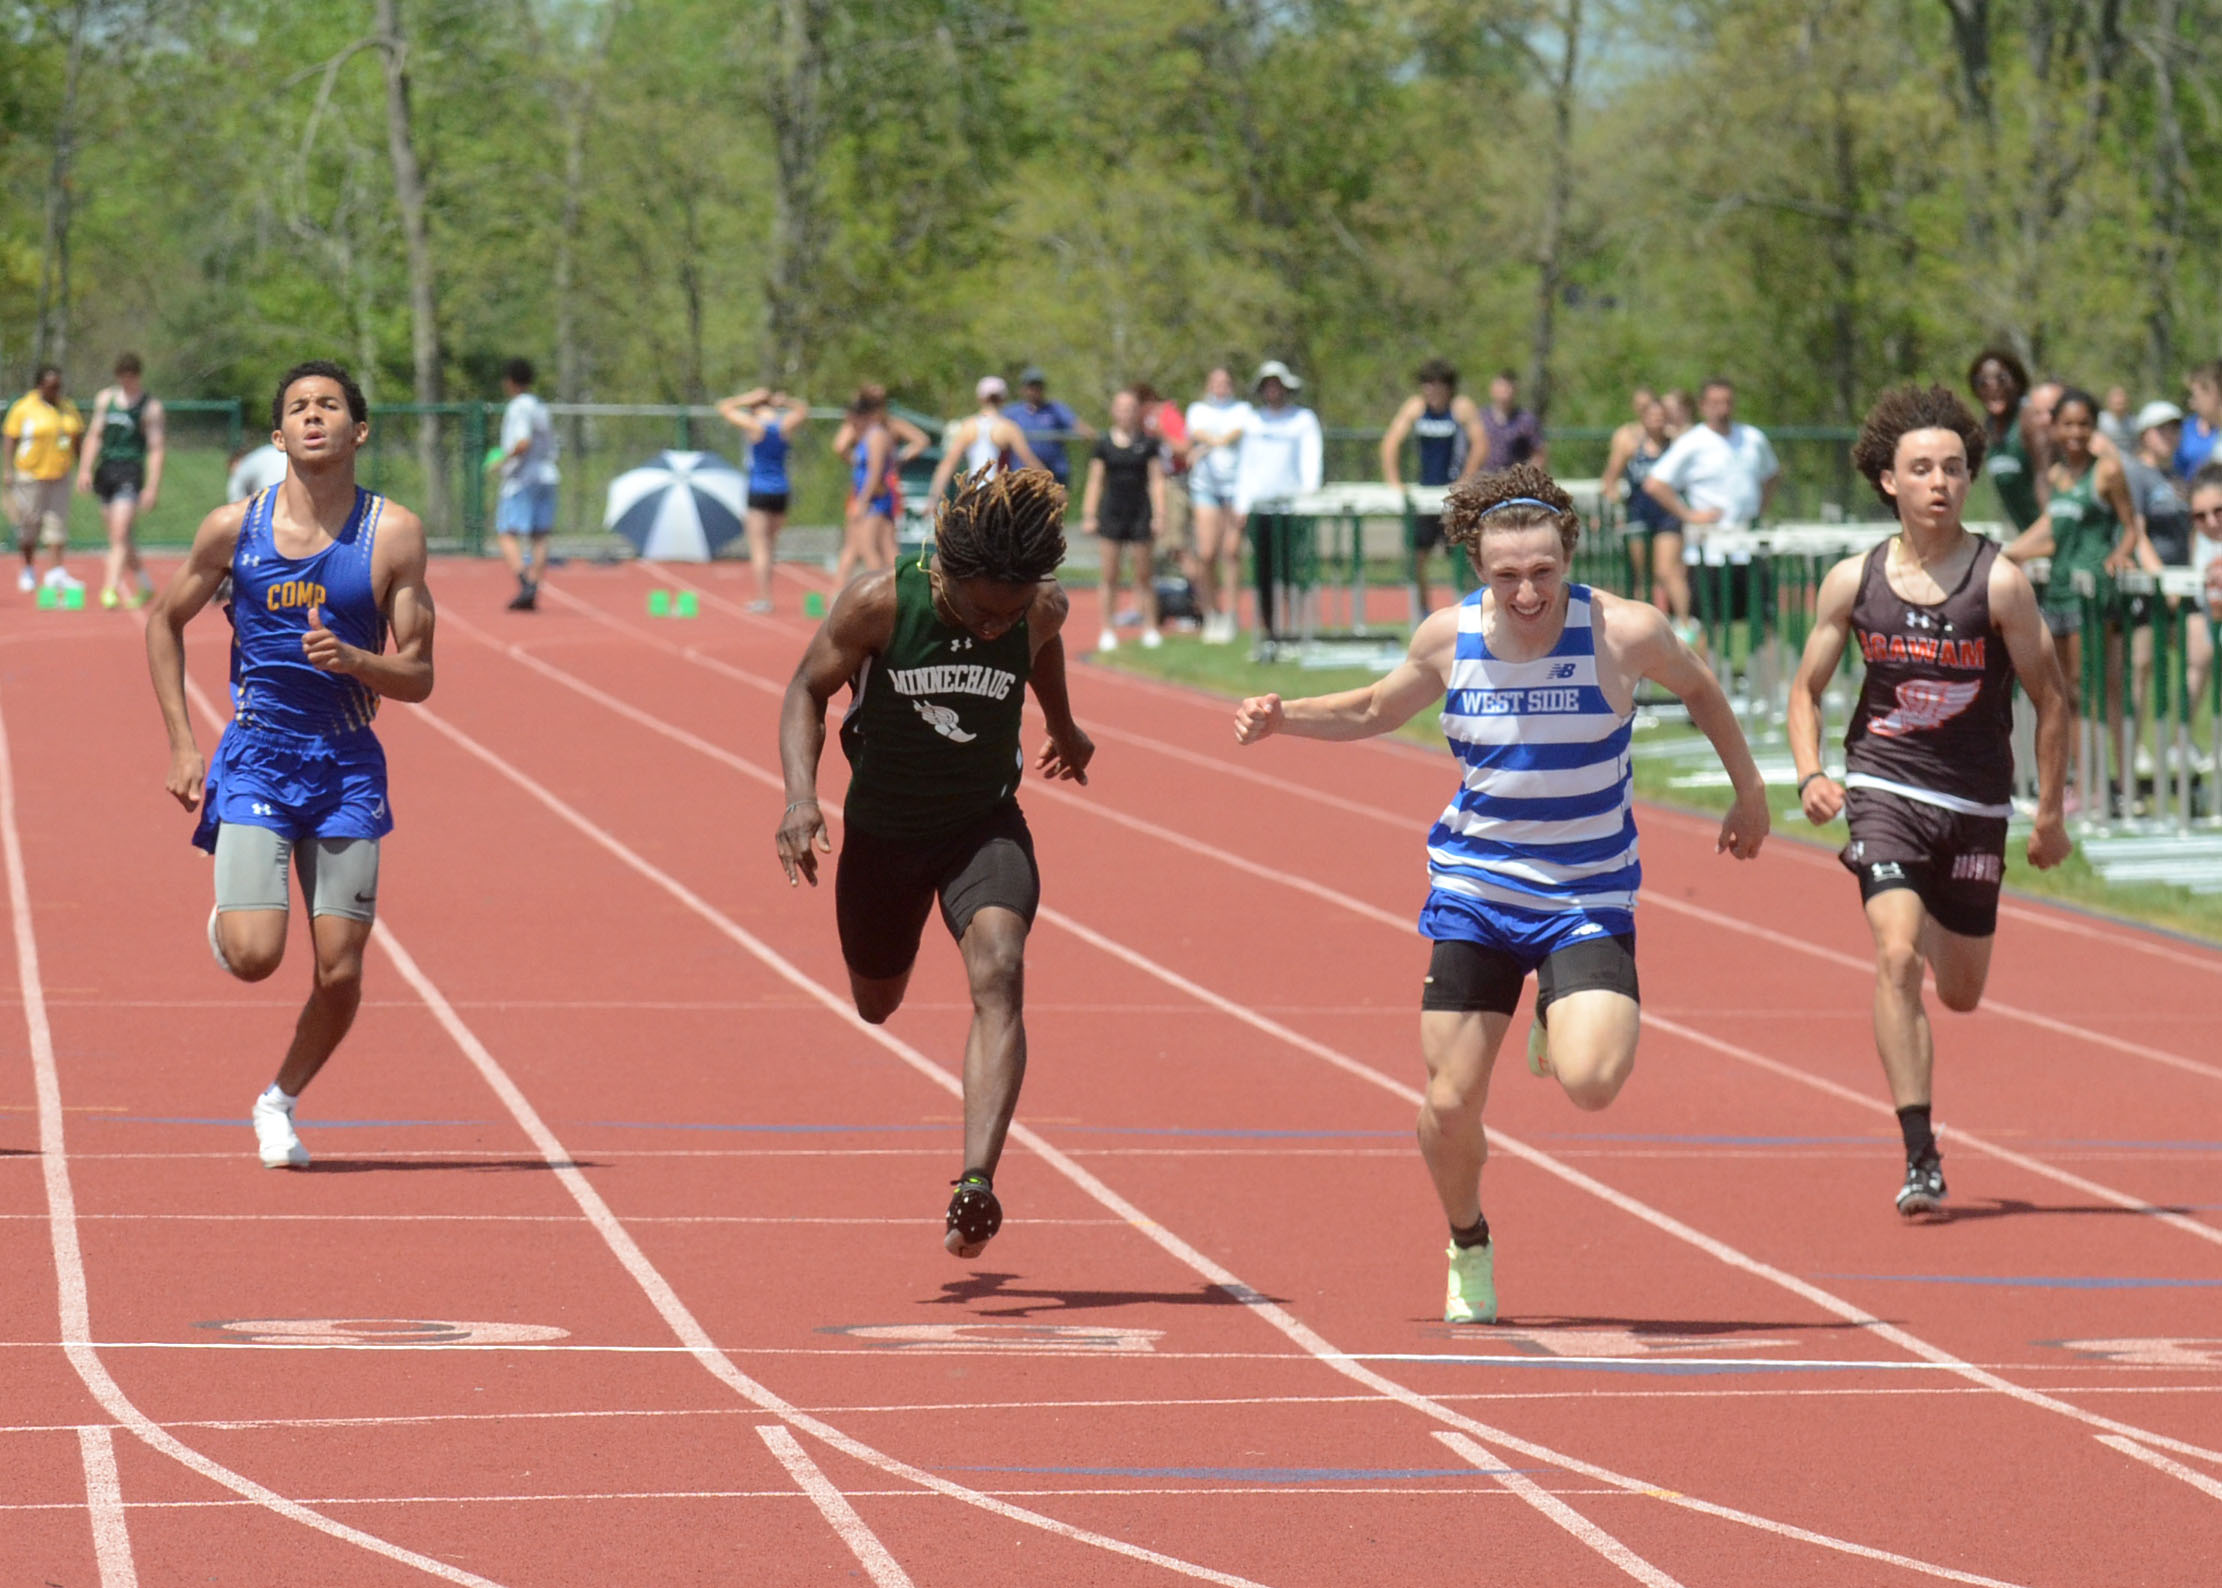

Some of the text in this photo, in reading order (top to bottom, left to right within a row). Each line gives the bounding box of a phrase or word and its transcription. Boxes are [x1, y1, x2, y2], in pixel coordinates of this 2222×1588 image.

[267, 580, 326, 611] COMP
[887, 664, 1016, 701] MINNECHAUG
[1461, 689, 1580, 714] WEST SIDE
